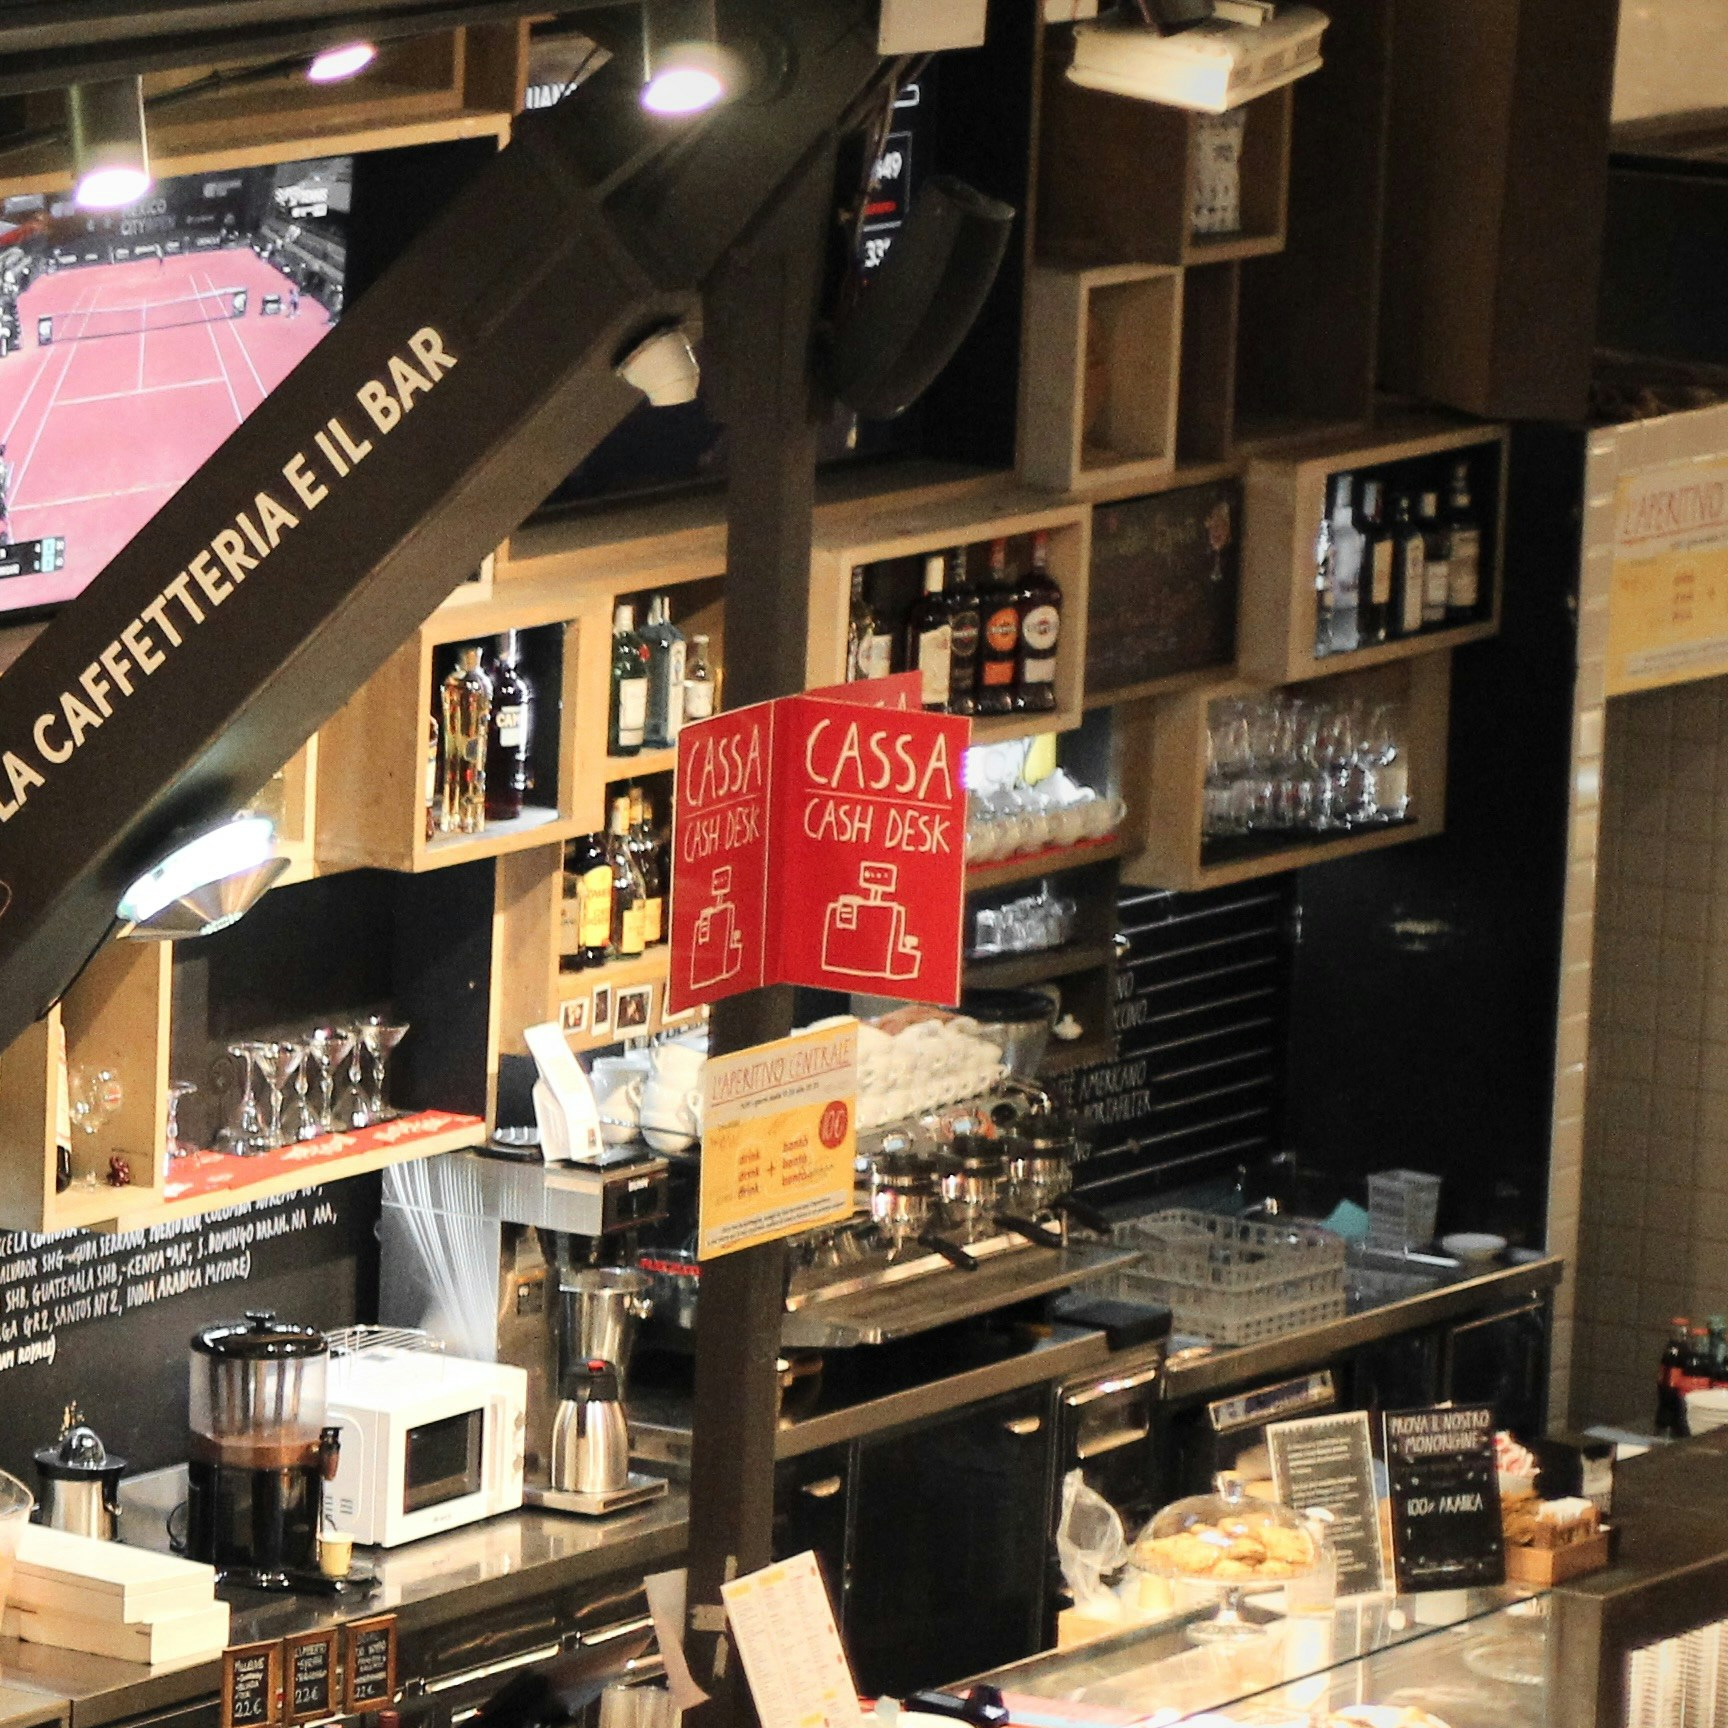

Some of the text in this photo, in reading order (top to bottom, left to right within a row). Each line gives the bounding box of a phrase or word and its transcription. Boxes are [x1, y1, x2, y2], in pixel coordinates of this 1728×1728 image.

[32, 491, 301, 765] CAFFETTERIA
[282, 451, 330, 511] E
[312, 417, 372, 478] IL
[356, 325, 459, 437] BAR
[685, 723, 762, 807] CASSA
[804, 718, 954, 801] CASSA
[683, 803, 760, 864] CASH DESK
[803, 797, 951, 854] CASH DESK
[32, 1267, 95, 1307] GUATEMALA
[54, 1296, 93, 1327] SANTOS
[126, 1279, 155, 1309] INDIA
[156, 1265, 203, 1300] ARABICA
[234, 1698, 262, 1718] 22€
